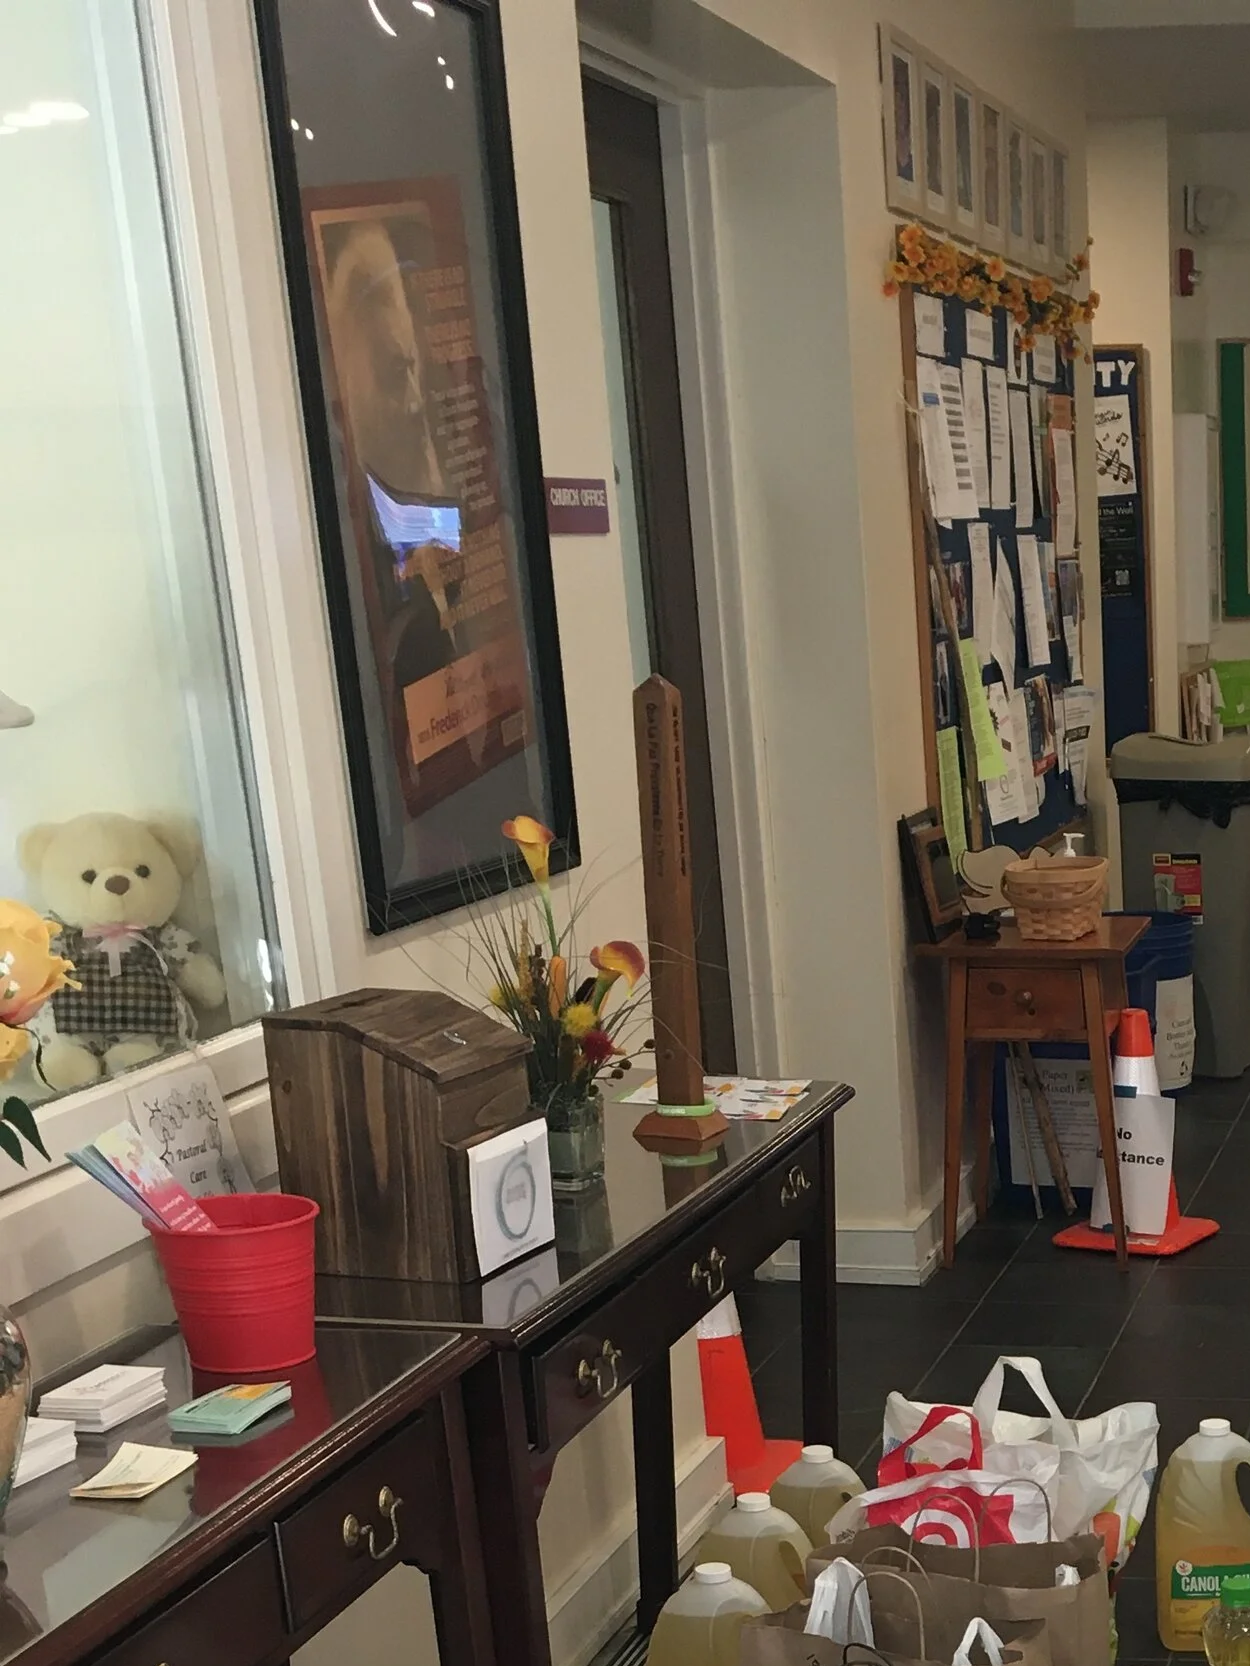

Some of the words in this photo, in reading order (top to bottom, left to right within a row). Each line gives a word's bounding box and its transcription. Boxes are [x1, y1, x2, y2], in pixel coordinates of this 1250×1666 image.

[1096, 359, 1136, 388] TY
[550, 487, 580, 506] CHURCH
[580, 488, 606, 507] OFFICE
[1042, 1069, 1068, 1080] Paper
[1116, 1127, 1133, 1140] No
[175, 1138, 208, 1161] Pastoral
[189, 1169, 208, 1184] Care
[1181, 1574, 1228, 1592] CANOL
